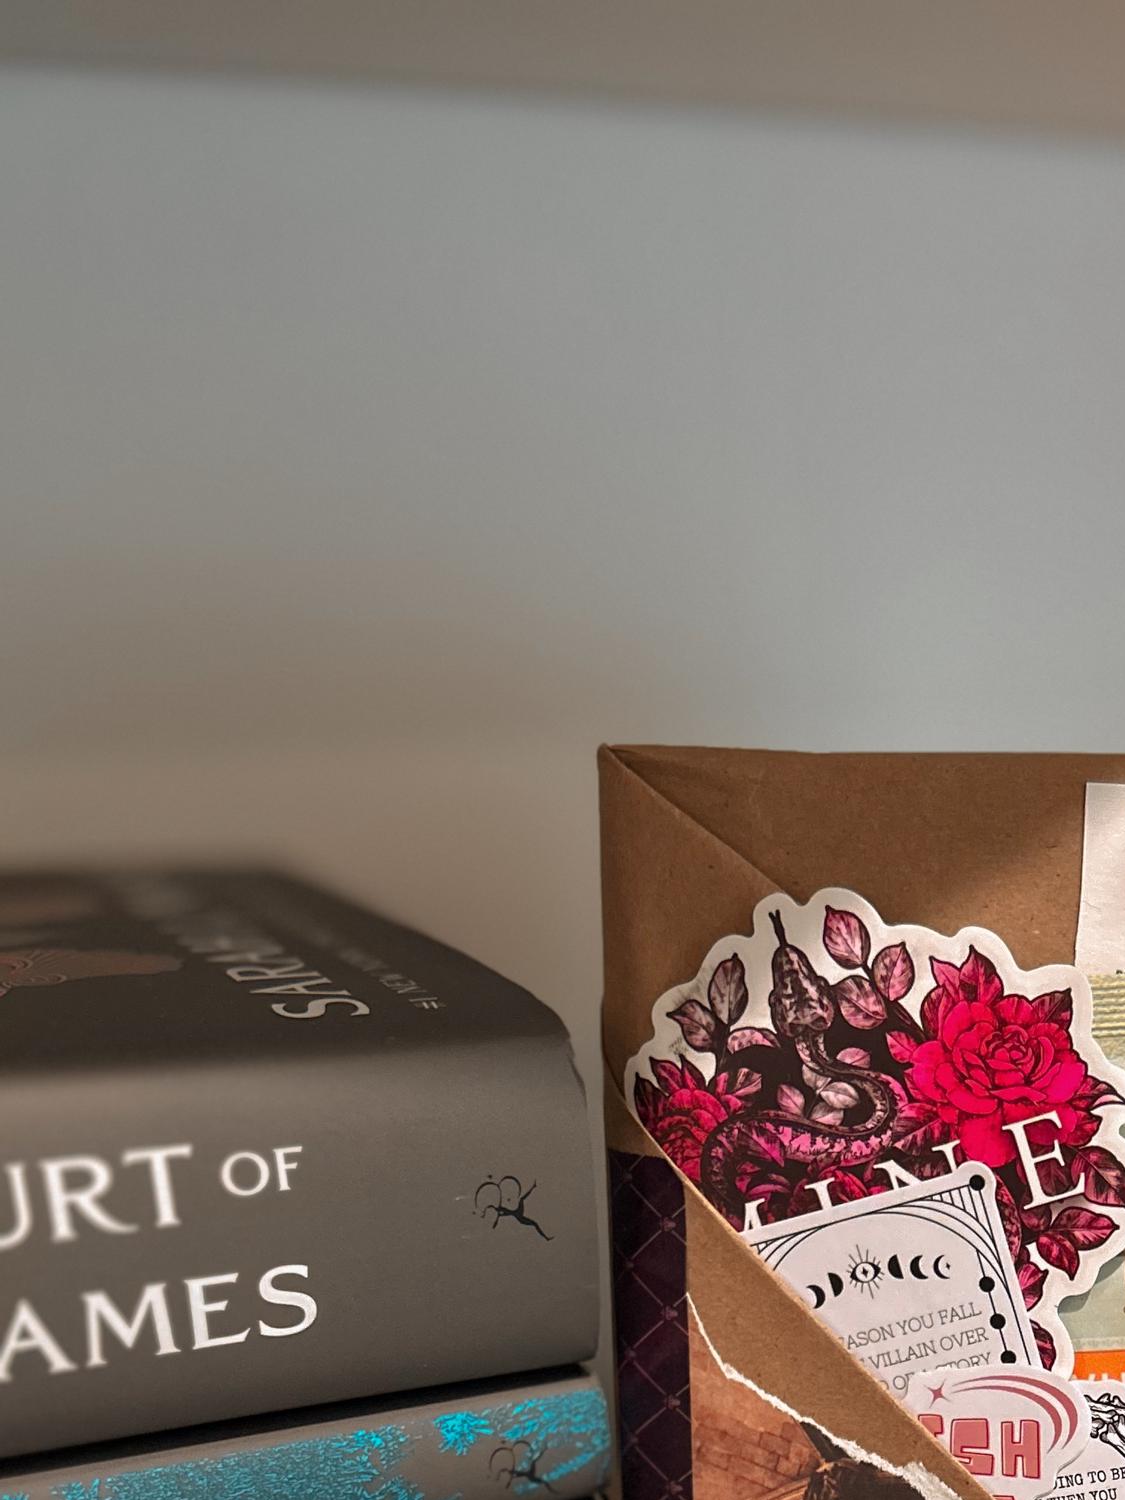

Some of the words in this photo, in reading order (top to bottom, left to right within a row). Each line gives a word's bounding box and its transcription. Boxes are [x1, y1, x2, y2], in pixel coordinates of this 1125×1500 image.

[220, 1145, 303, 1197] OF
[0, 1263, 318, 1384] AMES
[896, 1313, 935, 1337] YOU
[937, 1302, 983, 1326] FALL
[867, 1340, 938, 1370] VILLAIN
[940, 1326, 990, 1352] OVER
[1087, 1470, 1107, 1484] TO
